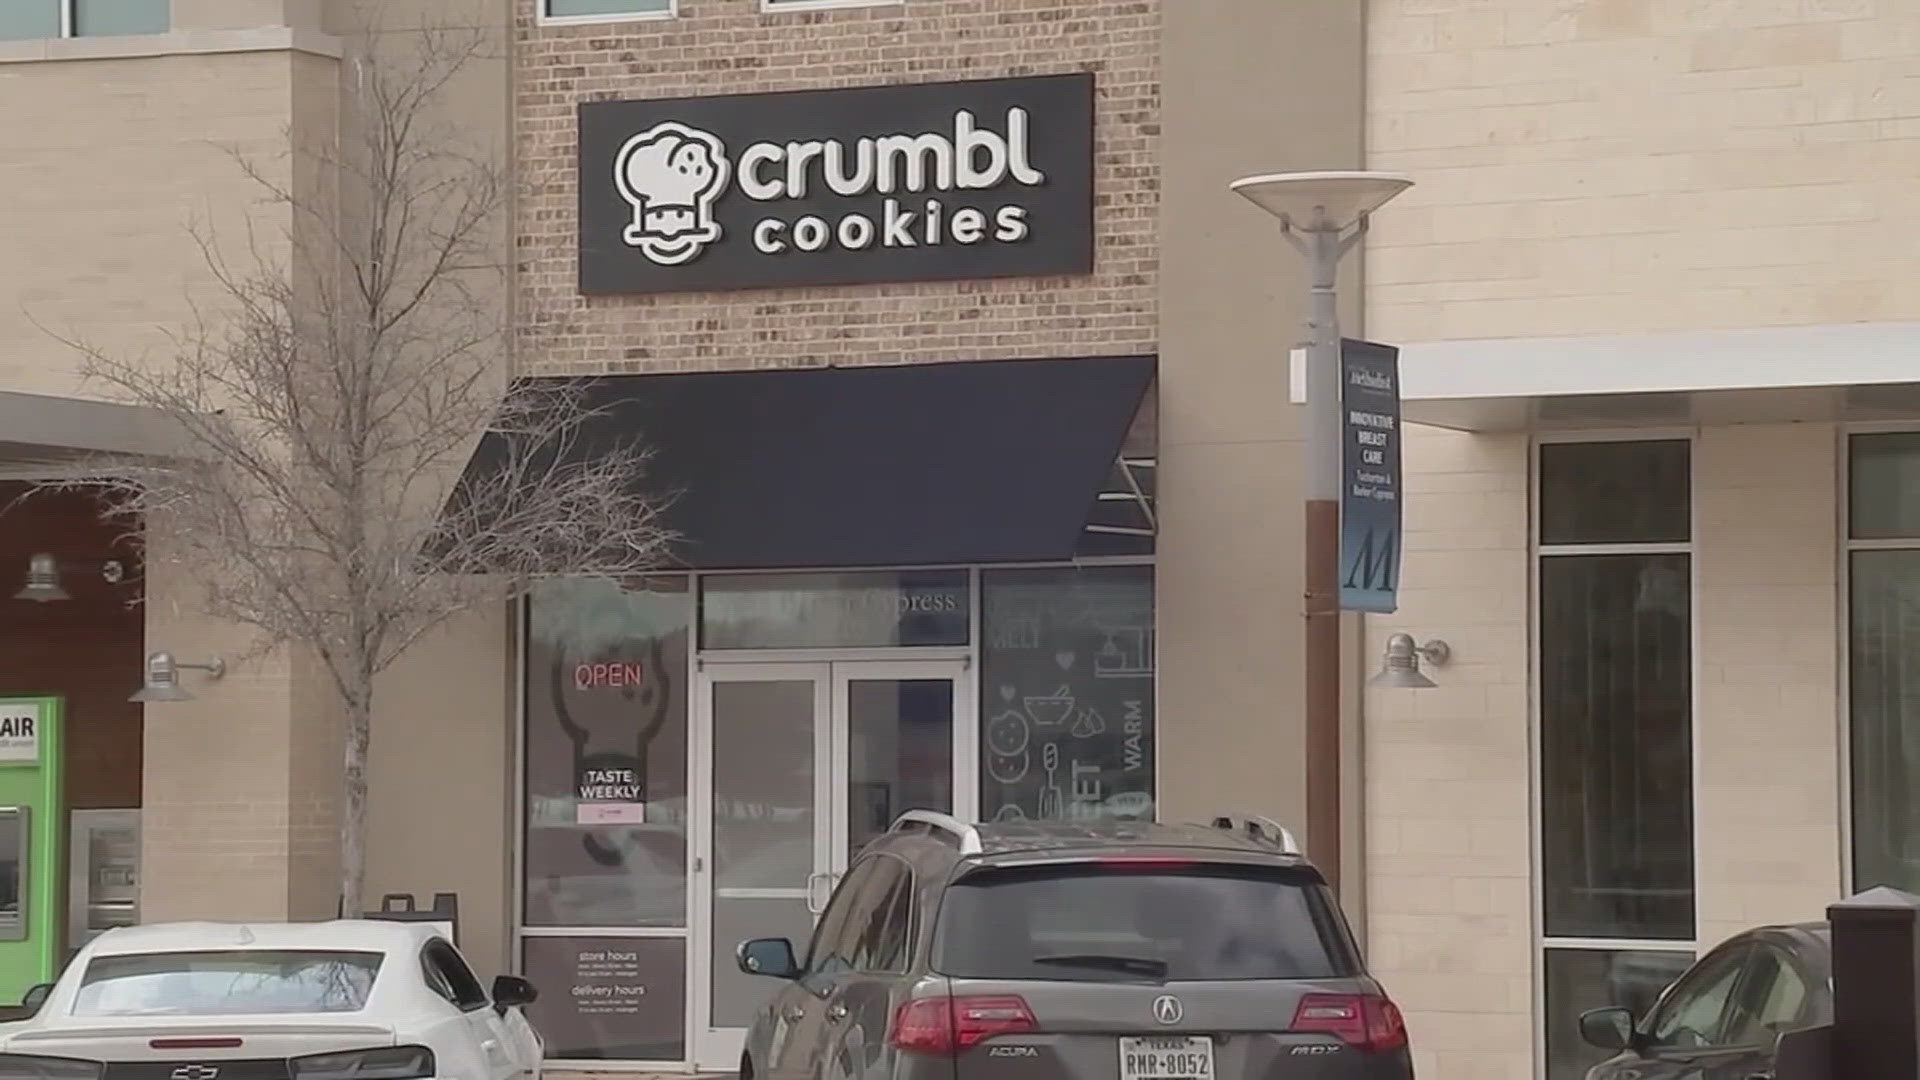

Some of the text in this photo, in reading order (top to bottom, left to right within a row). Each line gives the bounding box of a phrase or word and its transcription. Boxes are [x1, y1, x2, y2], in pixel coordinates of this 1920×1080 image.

[737, 106, 1045, 200] crumbl
[753, 200, 1028, 253] cookies
[1358, 430, 1387, 446] BREAST
[1363, 449, 1383, 464] CARE
[1343, 524, 1394, 591] M
[575, 663, 641, 687] OPEN
[1124, 700, 1141, 771] WARM
[588, 770, 632, 783] TASTE
[580, 785, 641, 799] WEEKLY
[607, 950, 637, 961] hours
[571, 985, 645, 997] delivery hours
[989, 1047, 1038, 1056] ACURA
[1291, 1046, 1341, 1055] MDX
